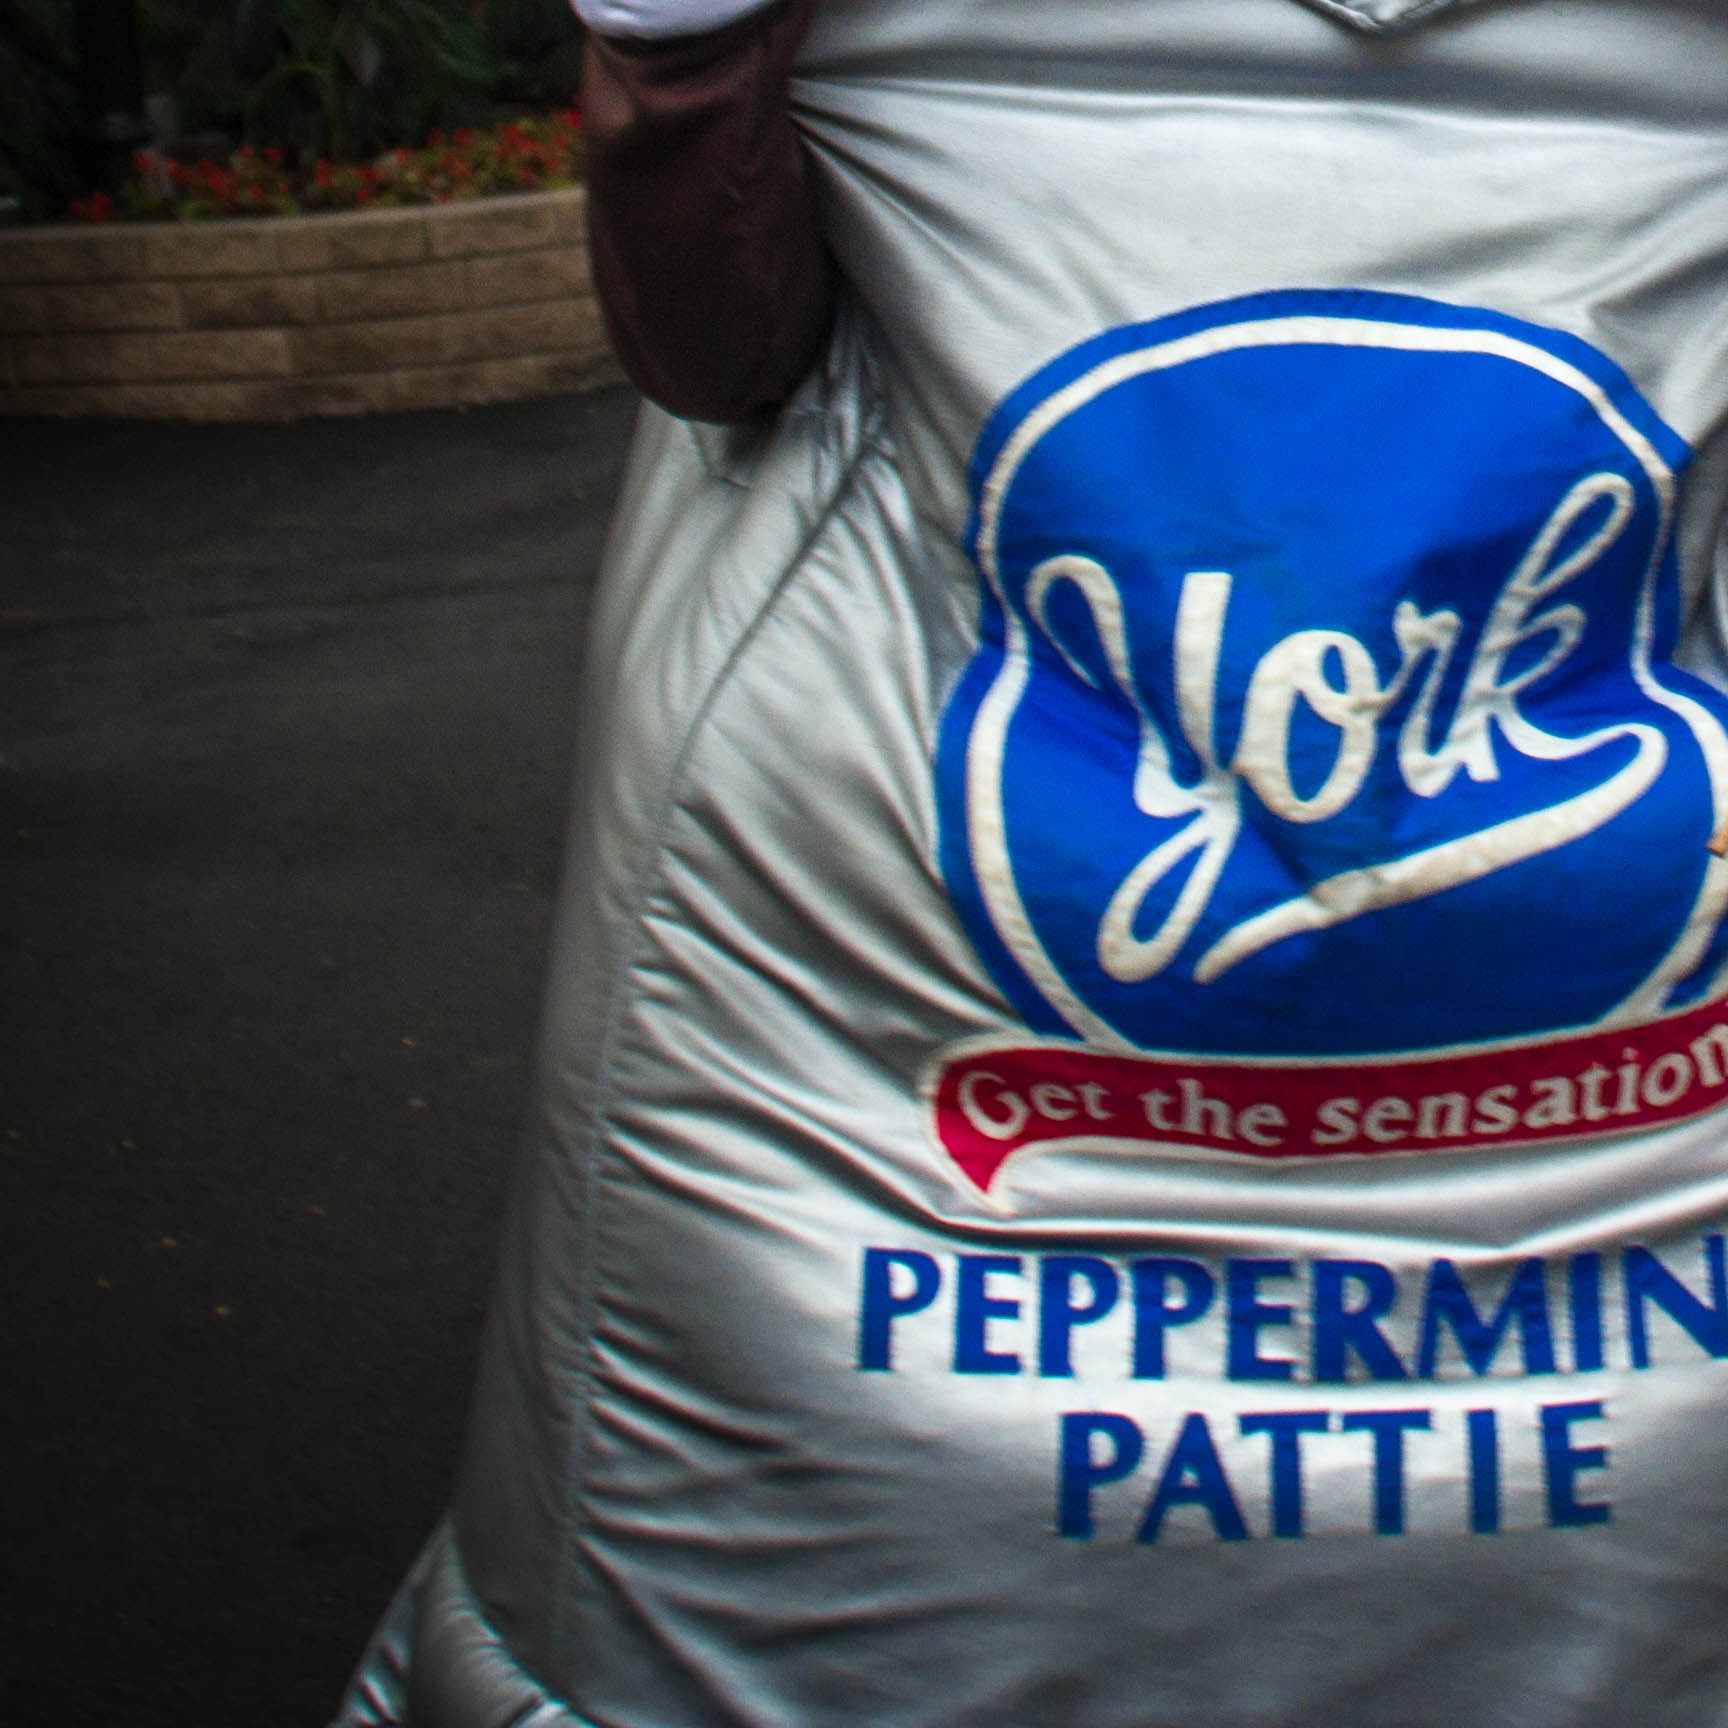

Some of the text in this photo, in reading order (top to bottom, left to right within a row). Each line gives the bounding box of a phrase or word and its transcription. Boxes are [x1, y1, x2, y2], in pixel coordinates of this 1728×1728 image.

[1025, 472, 1668, 985] York
[957, 1070, 1116, 1141] Get
[1138, 1077, 1287, 1146] the
[1056, 1399, 1611, 1542] PATTIE
